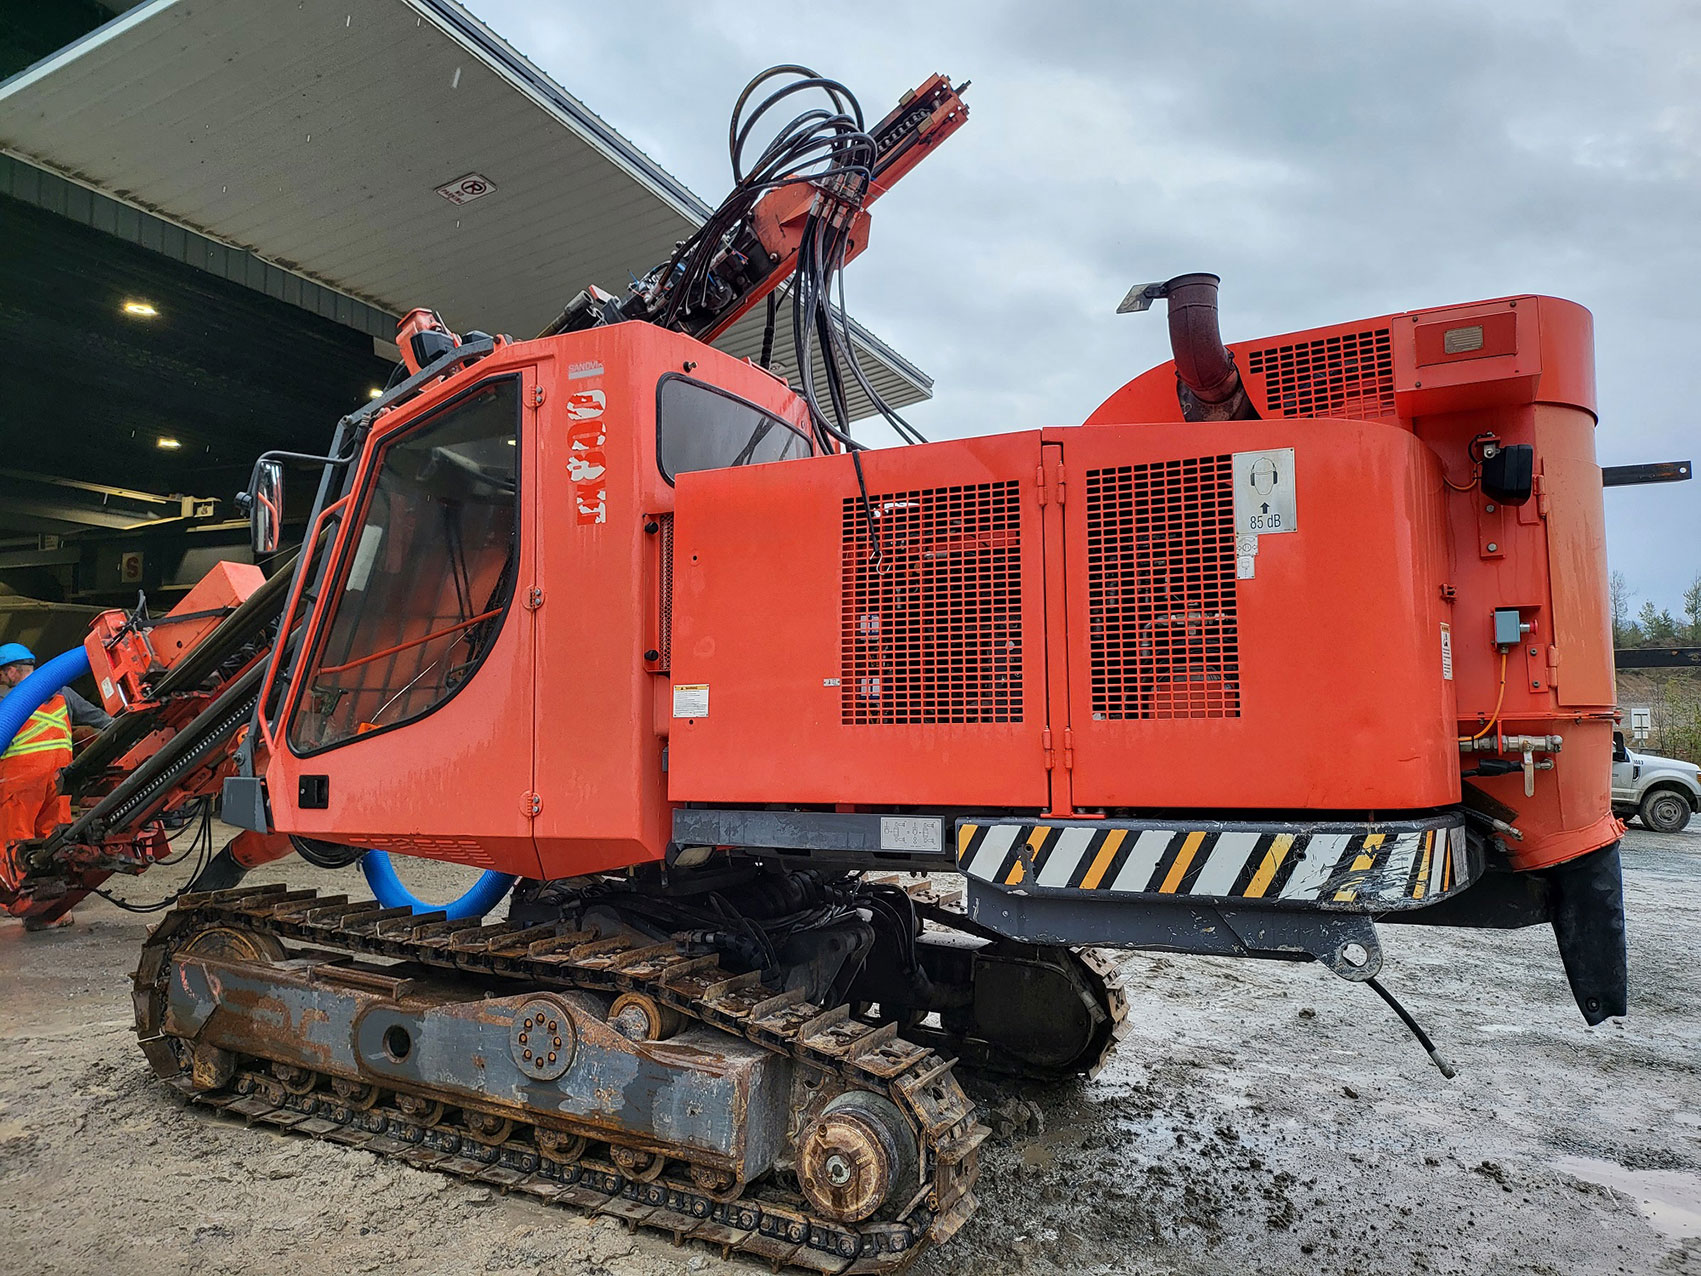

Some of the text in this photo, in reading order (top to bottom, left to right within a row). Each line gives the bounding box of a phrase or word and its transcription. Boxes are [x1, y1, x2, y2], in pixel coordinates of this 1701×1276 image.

[440, 189, 465, 204] PARKING
[1250, 514, 1281, 529] 85 dB
